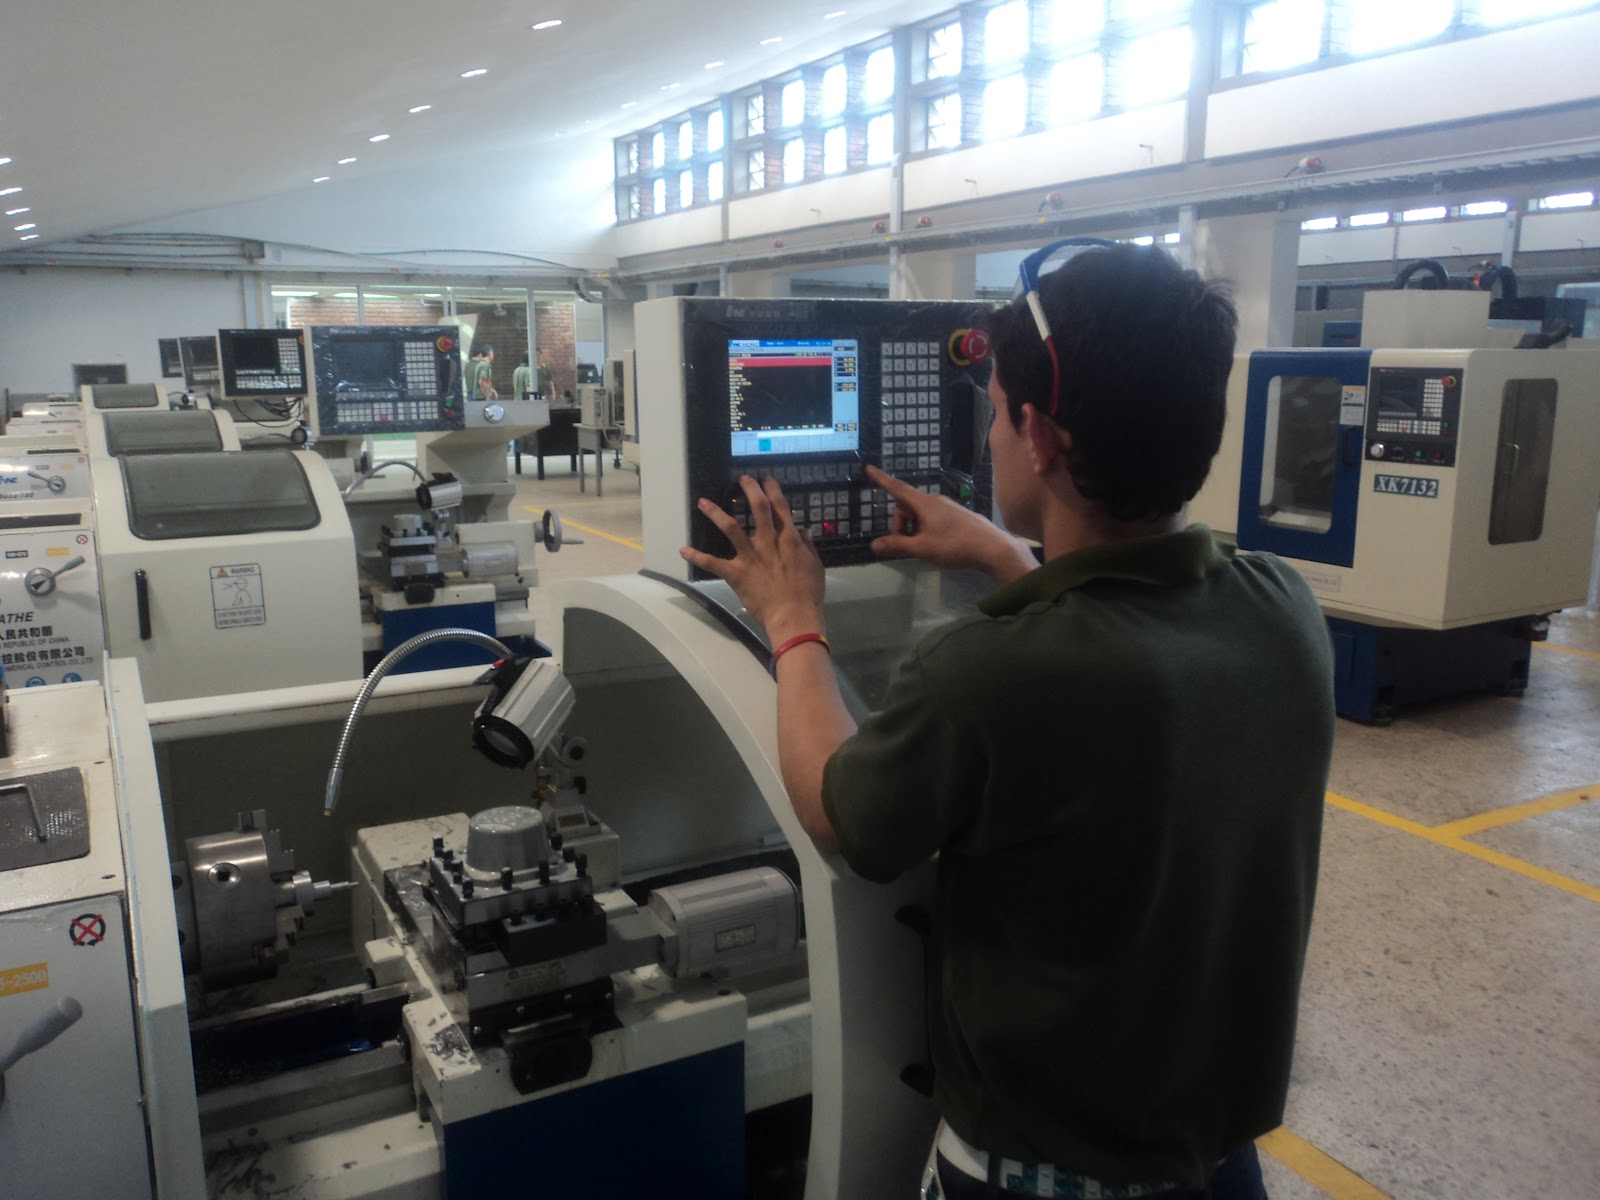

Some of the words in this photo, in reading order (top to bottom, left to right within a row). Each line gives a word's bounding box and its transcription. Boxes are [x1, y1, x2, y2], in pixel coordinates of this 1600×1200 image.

[1375, 475, 1437, 496] XK7132
[230, 566, 255, 574] WARNING
[3, 639, 35, 649] REPUBLIC
[38, 638, 46, 646] OF
[48, 636, 69, 644] CHINA
